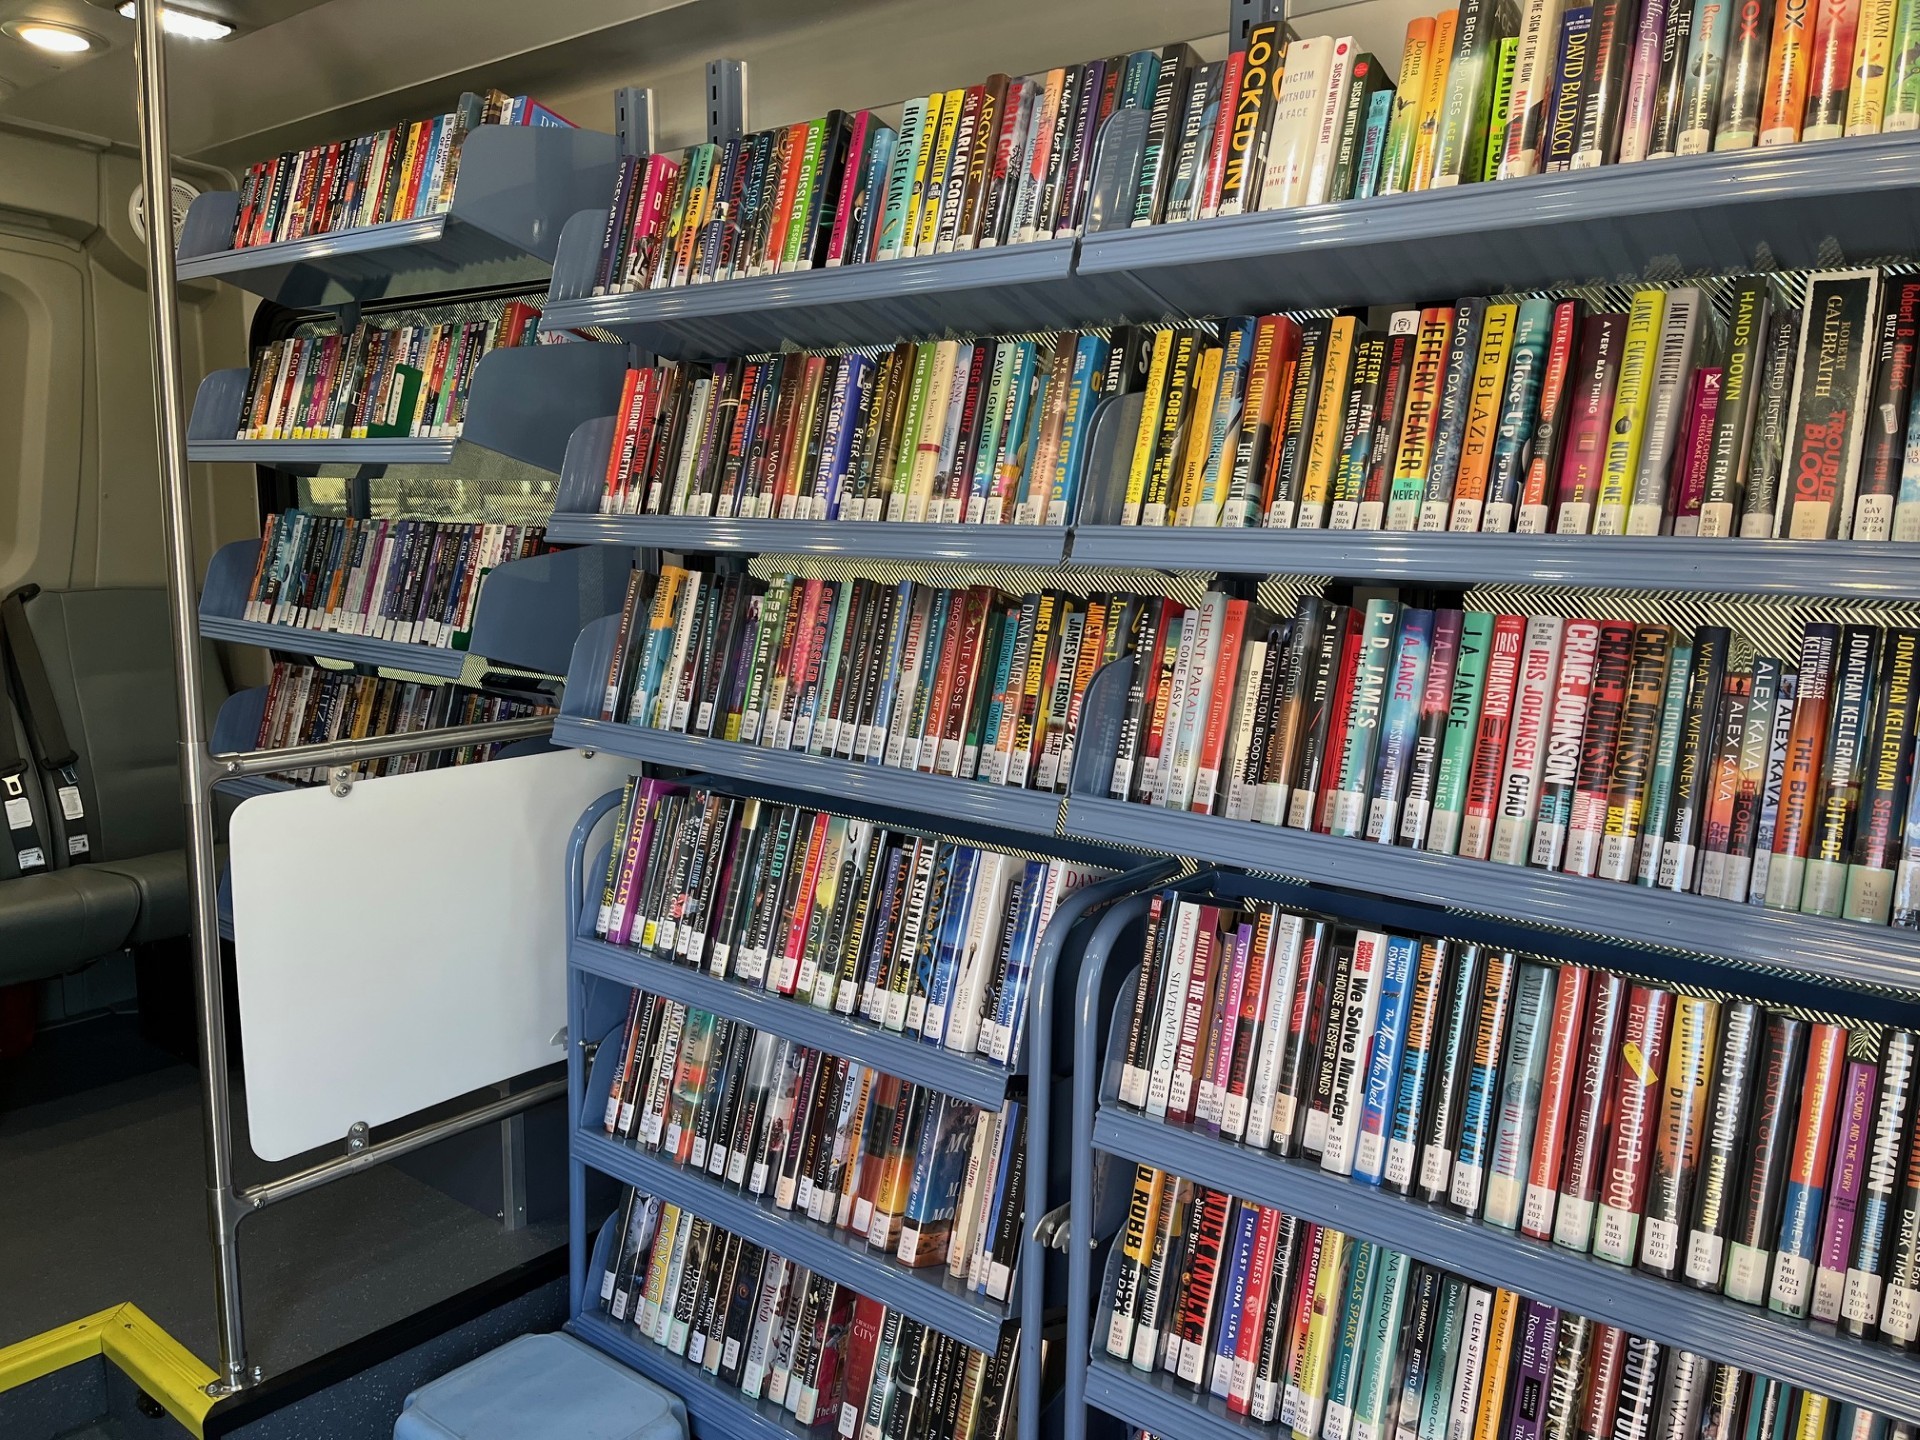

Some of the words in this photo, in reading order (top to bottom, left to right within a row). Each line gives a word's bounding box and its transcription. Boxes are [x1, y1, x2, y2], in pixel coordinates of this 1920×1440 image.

[1467, 0, 1480, 13] HE
[1401, 38, 1416, 84] Andrews
[1411, 40, 1426, 76] Donna
[1460, 16, 1476, 65] BROKEN
[1564, 33, 1587, 79] DAVID
[1160, 57, 1178, 80] THE
[1233, 26, 1276, 151] LOCKED
[1284, 71, 1314, 84] VICTIM
[1332, 63, 1343, 87] SUSAN
[1149, 83, 1172, 133] TURNOUT
[1186, 82, 1208, 137] EIGHTEEN
[1286, 107, 1308, 118] FACE
[1327, 89, 1338, 116] WITTIG
[1450, 70, 1465, 115] PLACES
[968, 94, 996, 184] ARGYLLE
[1321, 117, 1333, 144] ALBERT
[1552, 83, 1580, 156] BALDACCI
[804, 126, 819, 161] CLIVE
[887, 106, 920, 211] HOMESEEKING
[951, 116, 975, 178] HARLAN
[1178, 141, 1195, 179] BELOW
[614, 162, 626, 202] STACEY
[791, 165, 811, 220] CUSSLER
[1224, 160, 1244, 190] IN
[941, 179, 962, 230] COBEN
[603, 205, 618, 248] ABRAMS
[1454, 307, 1471, 346] DEAD
[1634, 299, 1653, 332] JANET
[1735, 291, 1755, 346] HANDS
[1885, 314, 1897, 339] BUZZ
[1252, 324, 1275, 375] MICHAEL
[1414, 320, 1446, 394] JEFFERY
[1451, 351, 1464, 369] BY
[1482, 313, 1507, 364] THE
[1599, 330, 1609, 356] VERY
[1774, 323, 1791, 390] SHATTERED
[1815, 294, 1843, 397] GALBRAITH
[1837, 322, 1851, 371] ROBERT
[1881, 342, 1894, 361] KILL
[974, 348, 984, 384] GREGG
[992, 350, 1006, 386] DAVID
[1106, 348, 1123, 392] STALKER
[1173, 338, 1192, 387] HARLAN
[1298, 346, 1315, 392] PATRICIA
[1594, 360, 1606, 379] BAD
[1620, 341, 1646, 404] EVANOVICH
[1725, 353, 1746, 401] DOWN
[635, 381, 643, 392] THE
[1243, 378, 1265, 433] CONNELLY
[1442, 374, 1460, 419] DAWN
[1588, 381, 1602, 414] THING
[630, 394, 643, 431] BOURNE
[961, 386, 978, 433] HURWITZ
[980, 392, 997, 449] IGNATIUS
[1163, 392, 1182, 431] COBEN
[1289, 393, 1309, 433] CORNWELL
[1466, 375, 1496, 456] BLAZE
[1764, 394, 1781, 441] JUSTICE
[617, 432, 635, 479] VENDETTA
[1400, 401, 1431, 471] DEAVER
[1019, 604, 1034, 637] DIANA
[1066, 618, 1081, 657] JAMES
[1183, 617, 1195, 643] LIES
[1198, 604, 1213, 663] SILENT
[904, 615, 922, 672] BOYFRIEND
[962, 626, 975, 660] KATE
[1009, 640, 1027, 685] PALMER
[1163, 647, 1176, 666] NO
[1177, 646, 1190, 675] COME
[1557, 625, 1598, 686] CRAIG
[1696, 642, 1714, 686] WHAT
[1526, 650, 1550, 681] IRIS
[1751, 661, 1773, 712] ALEX
[1843, 632, 1870, 701] JONATHAN
[952, 666, 968, 709] MOSSE
[1051, 657, 1075, 718] PATTERSON
[1151, 670, 1172, 737] ACCIDENT
[1169, 678, 1184, 707] EASY
[1184, 666, 1204, 732] PARADE
[1358, 664, 1385, 729] JAMES
[1693, 685, 1706, 710] THE
[1512, 684, 1543, 770] JOHANSEN
[1544, 687, 1586, 786] JOHNSON
[1685, 714, 1703, 750] WIFE
[1742, 719, 1765, 771] KAVA
[1832, 706, 1857, 788] KELLERMAN
[1505, 774, 1530, 817] CHAO
[1679, 755, 1697, 799] KNEW
[633, 798, 648, 844] HOUSE
[627, 847, 637, 866] OF
[770, 844, 786, 877] ROBB
[918, 845, 933, 876] LISA
[618, 869, 633, 904] GLAS
[901, 878, 926, 964] SCOTTOLINE
[1176, 910, 1192, 965] MAITLAND
[1354, 940, 1367, 970] OSMAN
[1362, 942, 1374, 973] RICHARD
[1350, 977, 1369, 1003] We
[1341, 1005, 1362, 1053] Solve
[1592, 984, 1612, 1042] ANNE
[634, 1040, 643, 1062] STEEL
[708, 1048, 723, 1093] ATLAS
[1582, 1044, 1606, 1099] PERRY
[1813, 1039, 1831, 1079] GRAVE
[1885, 1041, 1914, 1087] IAN
[828, 1083, 840, 1119] MYSTIC
[1330, 1056, 1356, 1126] Murder
[1802, 1081, 1825, 1178] RESERVATIONS
[1867, 1093, 1908, 1194] RANKIN
[1016, 1153, 1024, 1169] HER
[1007, 1201, 1015, 1217] HER
[1703, 1155, 1726, 1225] EXTINCTION
[658, 1215, 671, 1263] EARLY
[1003, 1219, 1011, 1238] LOVE
[1245, 1218, 1254, 1237] THE
[1606, 1223, 1619, 1231] PER
[1241, 1244, 1249, 1271] LAST
[1253, 1236, 1267, 1285] BUSINESS
[1355, 1242, 1370, 1301] NICHOLAS
[1782, 1266, 1796, 1276] PRI
[649, 1268, 662, 1301] RISE
[1233, 1277, 1244, 1307] MONA
[1423, 1274, 1432, 1298] DANA
[1780, 1275, 1799, 1286] 2021
[853, 1325, 875, 1342] CITY
[1228, 1313, 1238, 1338] LISA
[1345, 1304, 1360, 1348] SPARKS
[1417, 1300, 1430, 1342] STABENOW
[1470, 1314, 1483, 1341] OLEN
[1526, 1314, 1540, 1342] Rose
[1541, 1319, 1557, 1361] Murder
[1523, 1345, 1535, 1368] Hill
[1539, 1362, 1550, 1374] in
[1460, 1345, 1477, 1414] STEINHAUER
